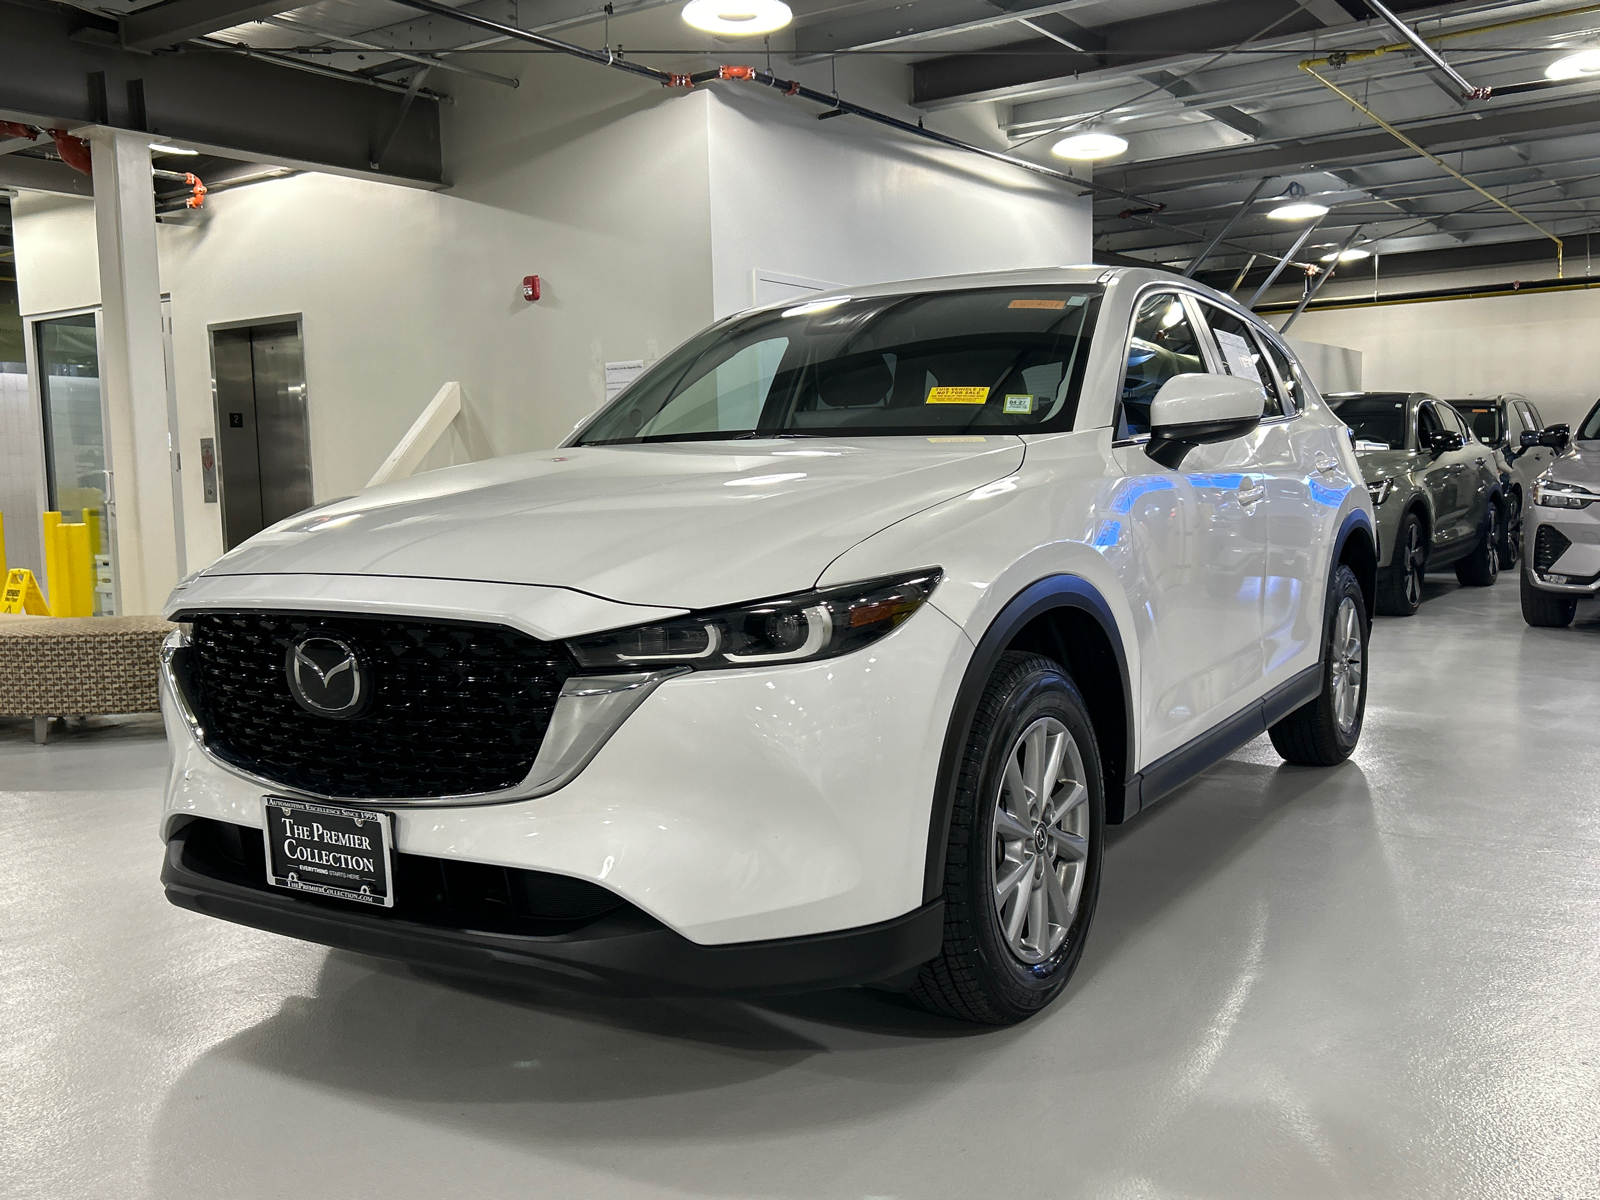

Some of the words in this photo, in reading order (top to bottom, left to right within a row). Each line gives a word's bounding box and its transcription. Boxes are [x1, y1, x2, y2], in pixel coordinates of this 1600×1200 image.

[233, 414, 239, 424] 2
[360, 812, 377, 821] 1995
[281, 818, 311, 840] THE
[311, 822, 372, 850] PREMIER
[283, 838, 375, 872] COLLECTION
[299, 865, 329, 875] EVERYTHING
[328, 870, 346, 879] STARTS
